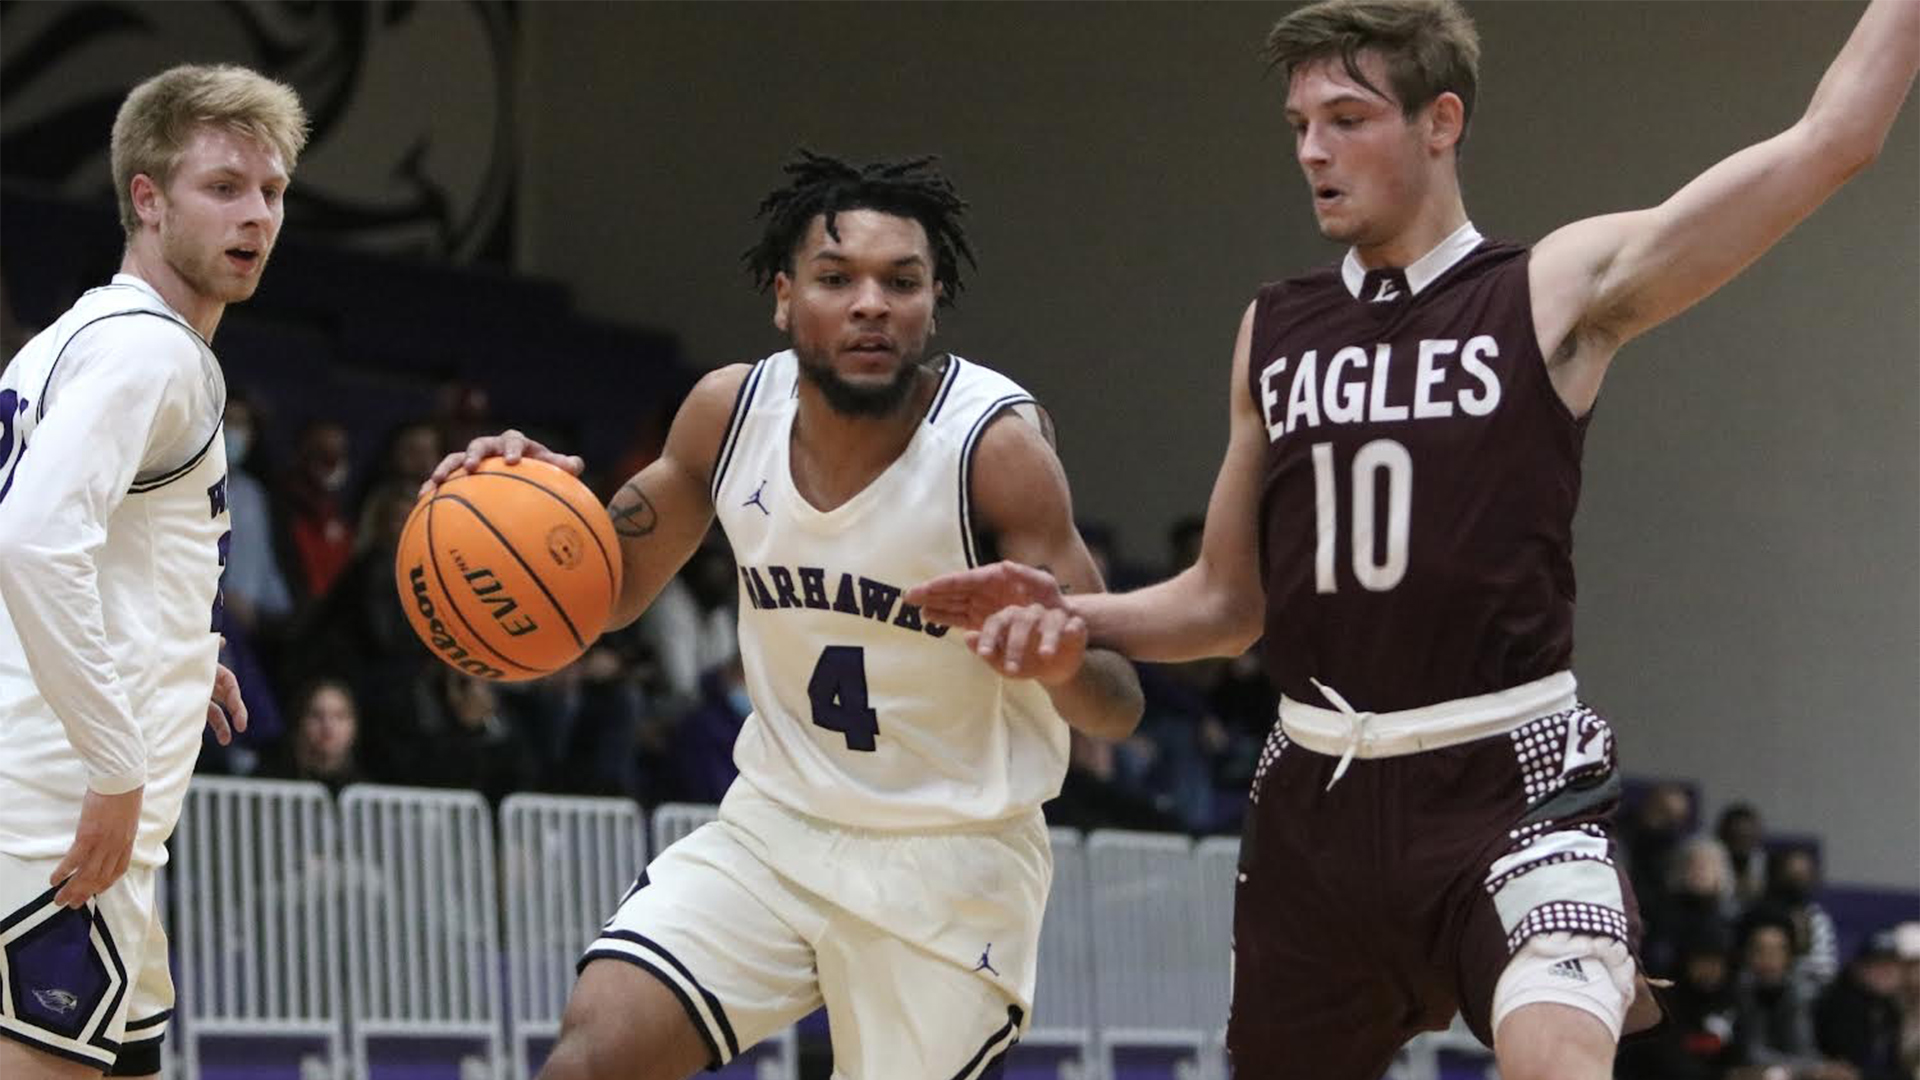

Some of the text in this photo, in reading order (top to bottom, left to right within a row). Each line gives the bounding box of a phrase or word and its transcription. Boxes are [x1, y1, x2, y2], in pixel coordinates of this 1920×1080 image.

[1259, 335, 1502, 443] EAGLES
[1311, 438, 1413, 595] 10
[806, 644, 881, 752] 4
